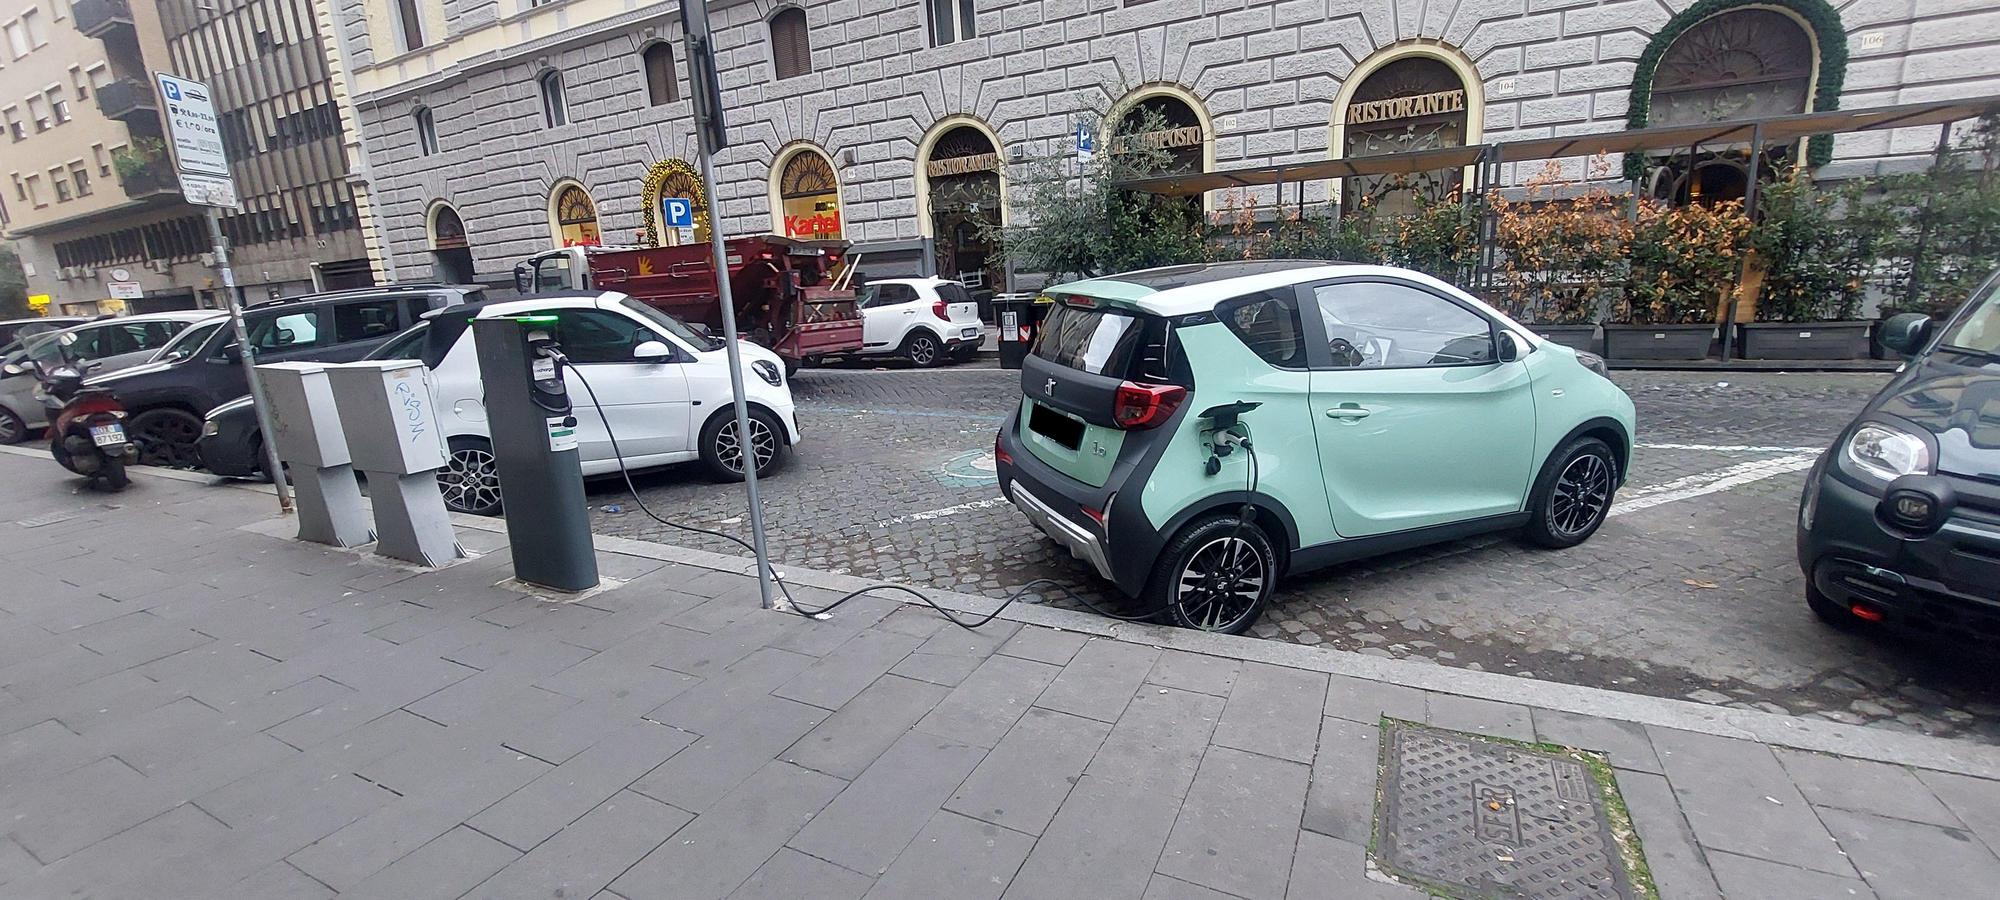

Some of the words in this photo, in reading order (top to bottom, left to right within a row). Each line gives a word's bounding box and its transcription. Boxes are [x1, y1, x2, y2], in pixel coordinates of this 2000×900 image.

[1863, 36, 1882, 46] 106
[167, 83, 177, 98] P
[1499, 82, 1514, 90] 104
[1347, 89, 1465, 124] RISTORANTE
[1012, 147, 1021, 156] 100
[927, 152, 998, 177] RISTORANTE
[670, 202, 685, 223] P
[96, 434, 124, 445] 87192
